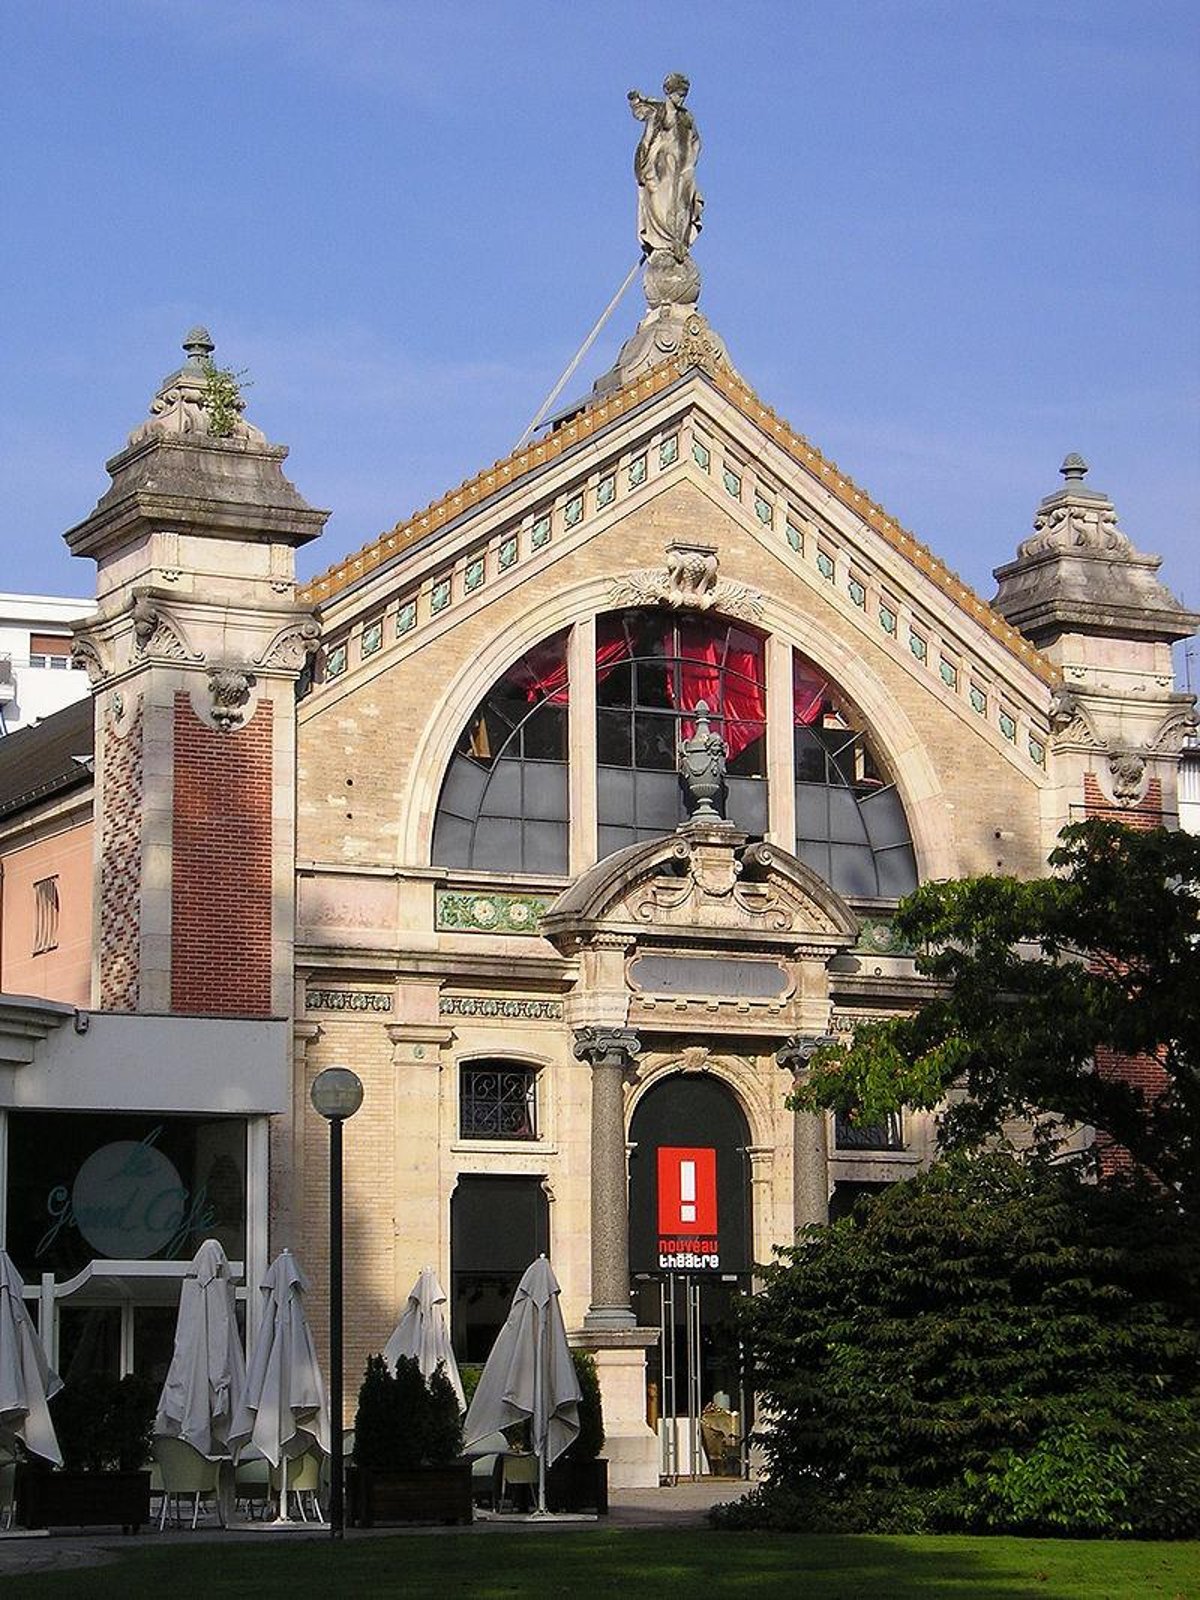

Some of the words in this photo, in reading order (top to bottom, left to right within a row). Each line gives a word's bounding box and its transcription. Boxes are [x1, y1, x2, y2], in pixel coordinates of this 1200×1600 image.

[35, 1186, 139, 1258] Grand
[144, 1185, 218, 1259] Café
[659, 1239, 718, 1253] nouveau
